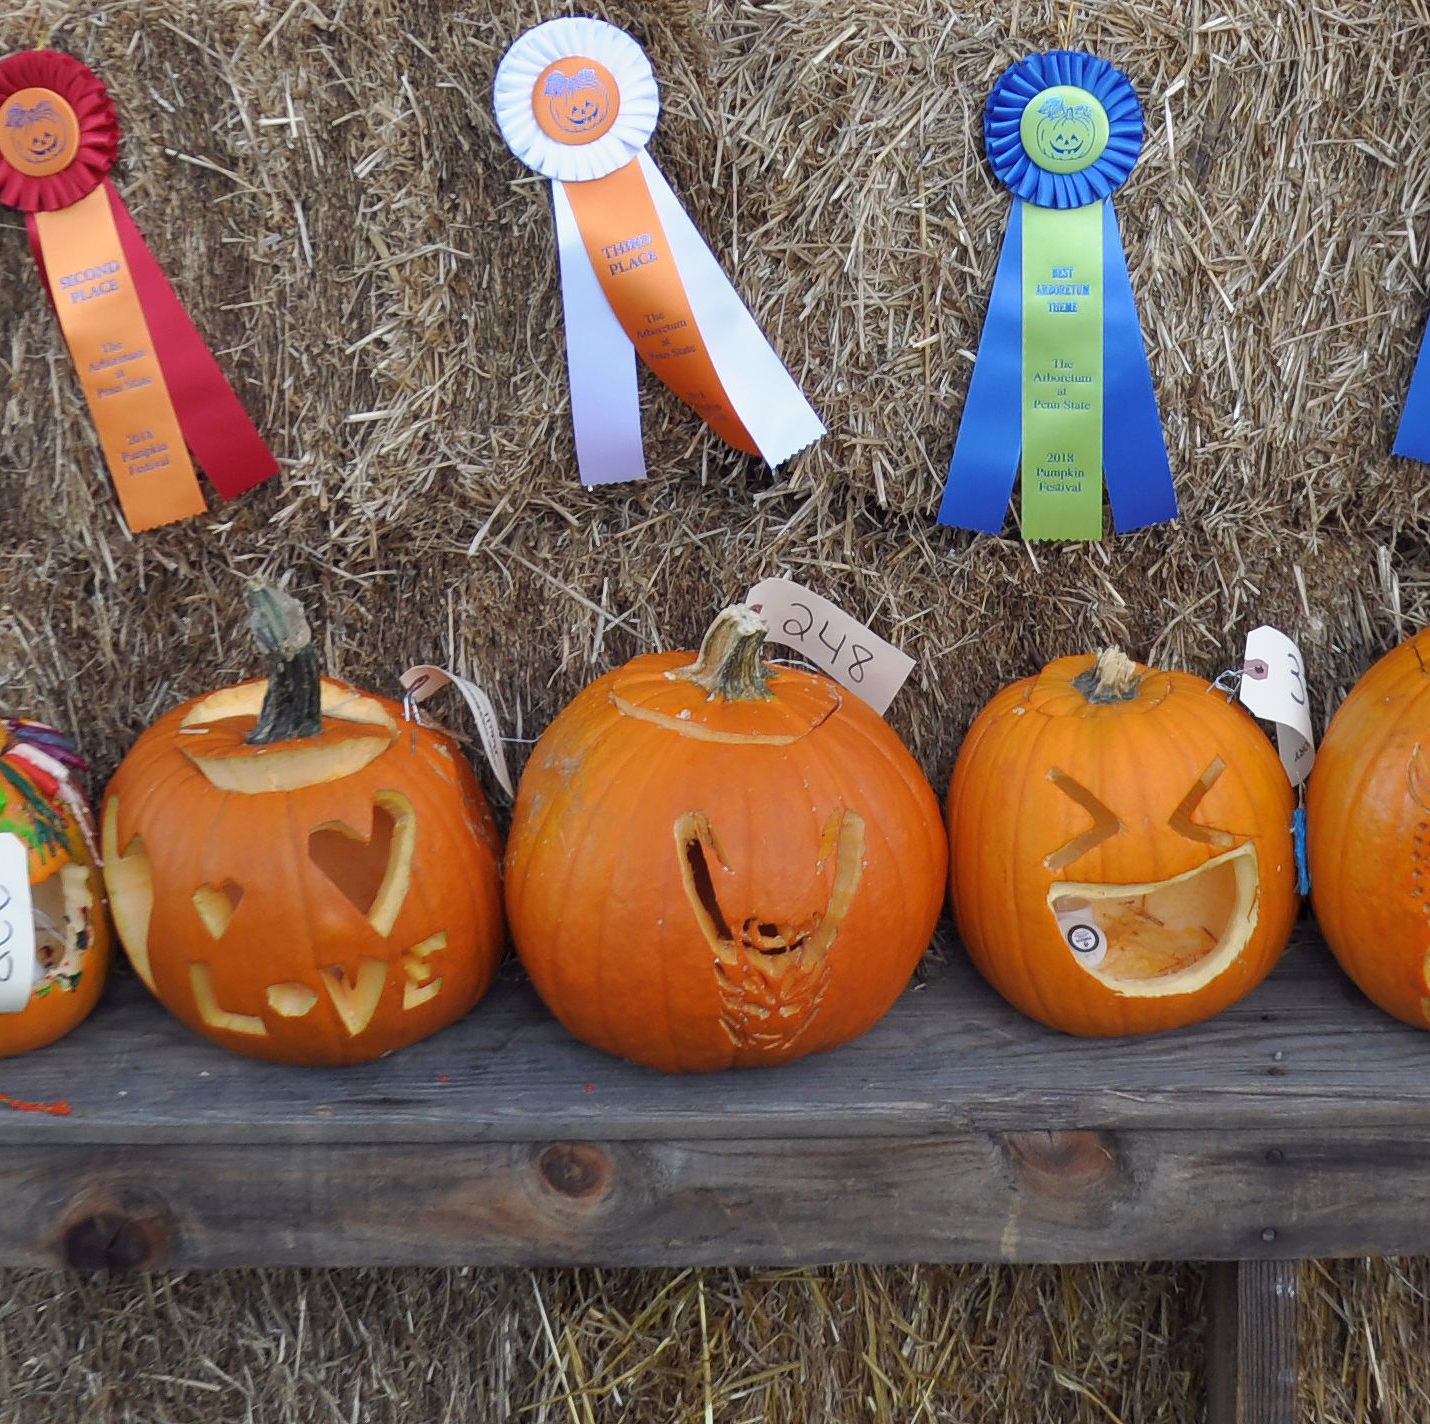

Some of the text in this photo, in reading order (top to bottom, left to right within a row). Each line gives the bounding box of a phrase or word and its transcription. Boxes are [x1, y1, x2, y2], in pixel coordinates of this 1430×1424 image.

[602, 234, 654, 260] THIRD
[608, 250, 658, 277] PLACE
[58, 262, 121, 290] SECOND
[1051, 267, 1075, 279] BEST
[69, 280, 120, 304] PLACE
[1034, 283, 1091, 297] ARBORETUM
[1047, 301, 1078, 313] THEME
[643, 311, 666, 324] The
[635, 318, 689, 340] Arboretum
[100, 341, 123, 354] The
[672, 344, 697, 359] State
[1051, 358, 1074, 370] The
[1032, 371, 1093, 383] Arboretum
[1056, 386, 1068, 396] at
[1033, 399, 1091, 411] Penn State
[121, 443, 170, 464] Pumpkin
[1046, 452, 1075, 464] 2018
[127, 456, 171, 477] Festival
[1036, 466, 1085, 481] Pumpkin
[1038, 480, 1082, 494] Festival
[781, 602, 875, 684] 248
